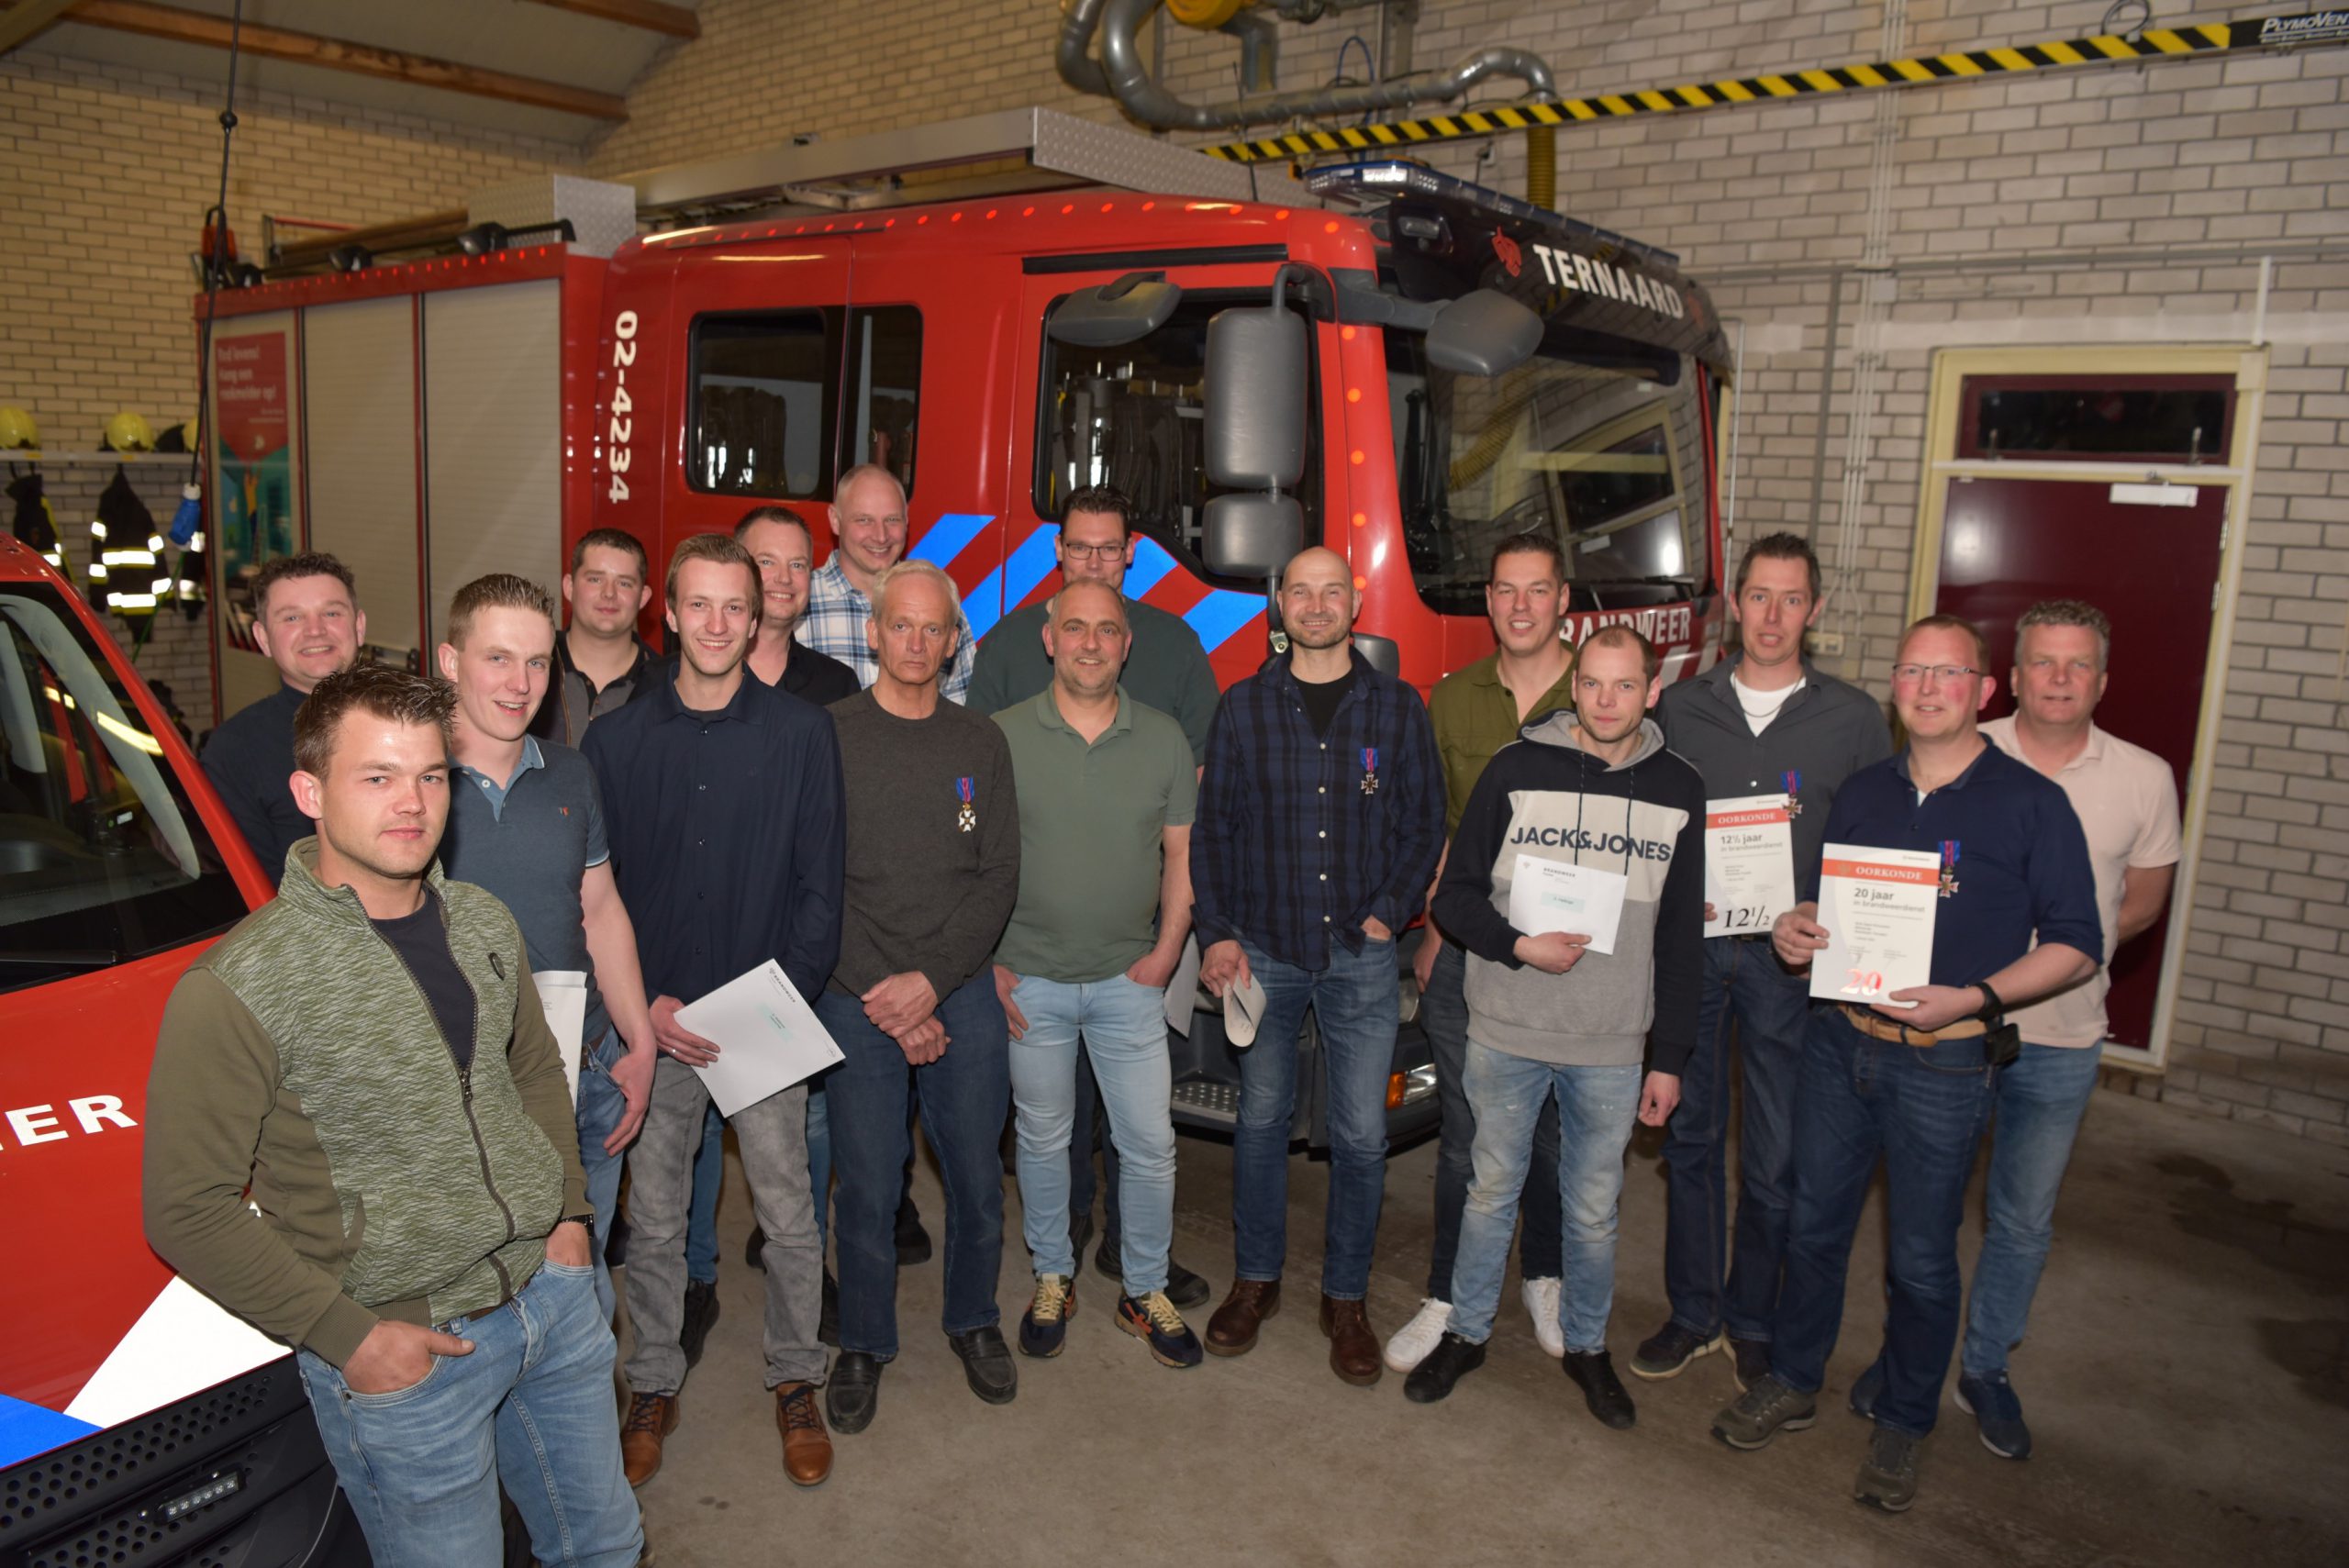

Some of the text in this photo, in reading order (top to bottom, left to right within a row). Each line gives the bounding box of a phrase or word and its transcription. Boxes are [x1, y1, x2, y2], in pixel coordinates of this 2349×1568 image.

[1532, 243, 1684, 319] TERNAARD
[608, 310, 638, 504] 02-4234
[1559, 606, 1690, 650] RAWEER
[1718, 812, 1776, 824] OORKONDE
[1510, 827, 1672, 862] JACK&JONES
[1743, 834, 1763, 845] jaar
[1855, 865, 1923, 881] OORKONDE
[1854, 887, 1894, 901] 20 jaar
[1840, 968, 1882, 996] 20
[0, 1094, 139, 1151] ER
